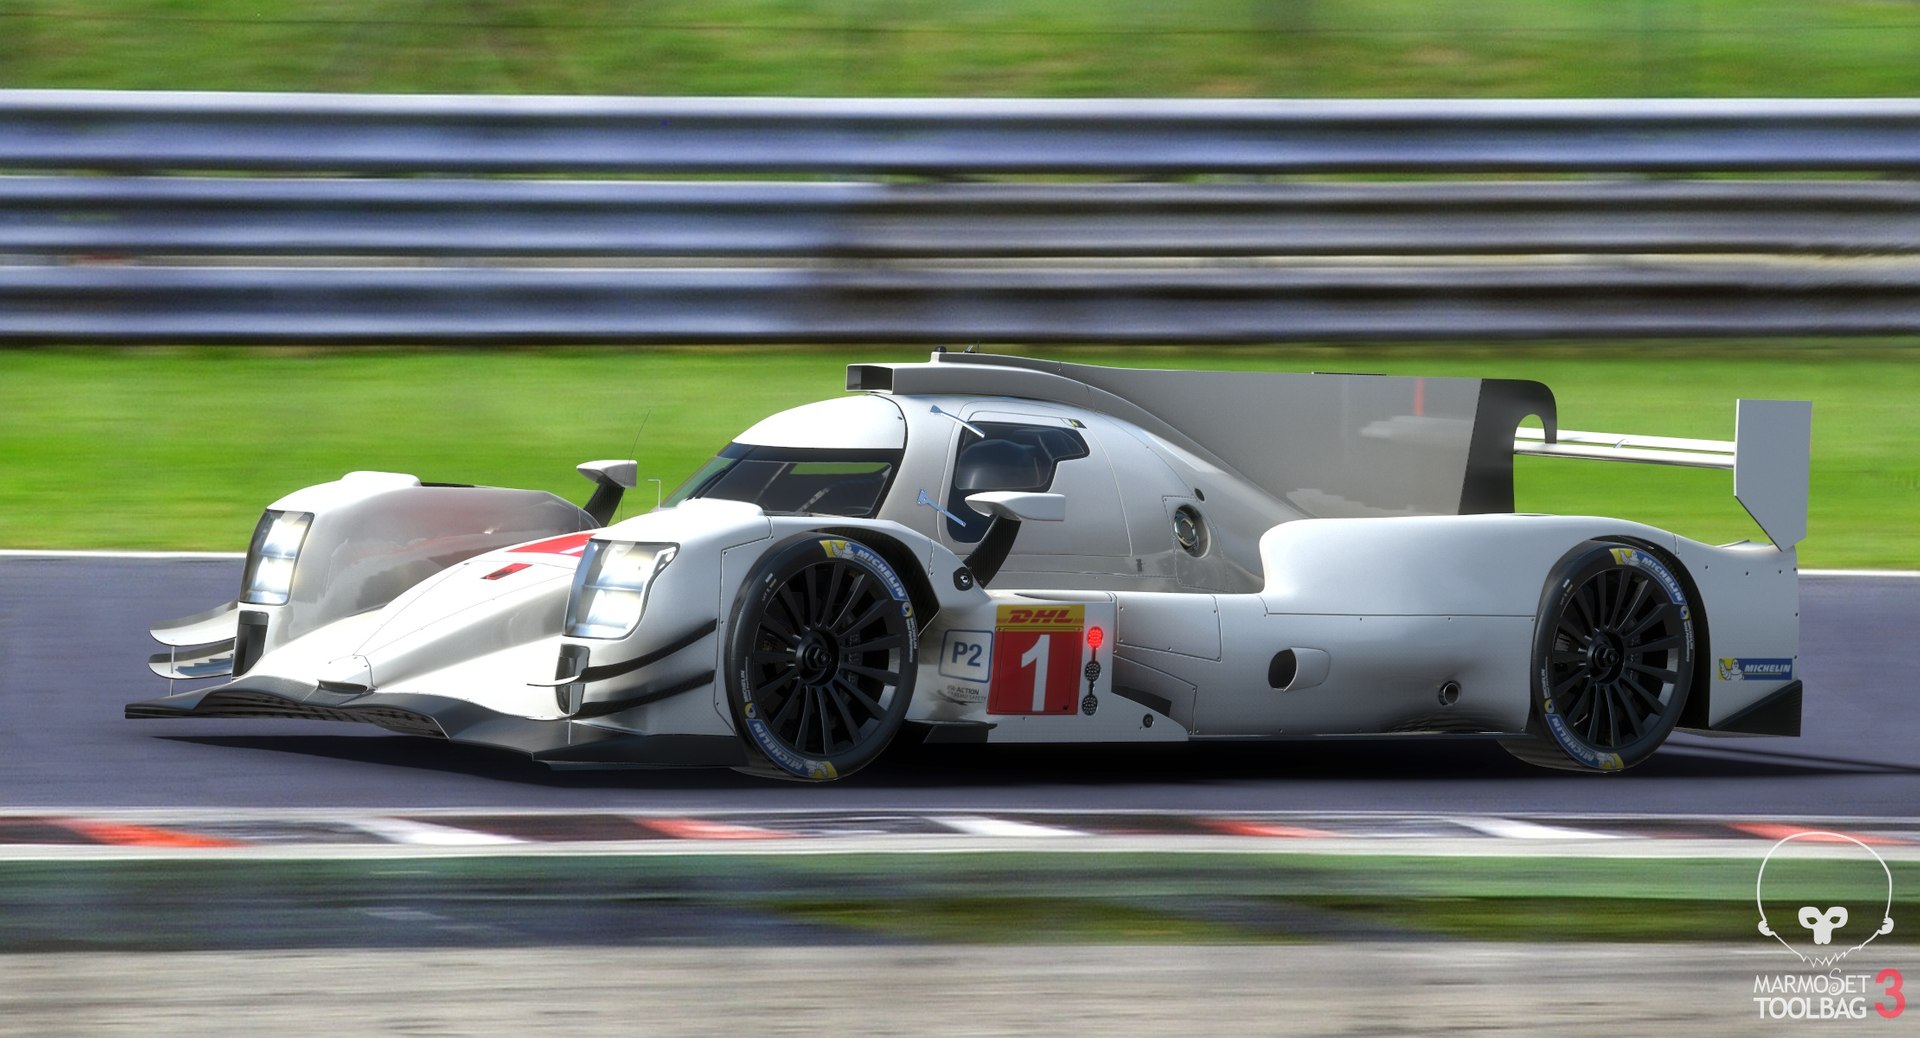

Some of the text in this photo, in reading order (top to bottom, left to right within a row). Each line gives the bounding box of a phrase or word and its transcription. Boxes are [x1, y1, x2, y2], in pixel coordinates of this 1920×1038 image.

[856, 549, 905, 599] MICHELIN
[1641, 556, 1684, 602] MICHELIN
[1008, 609, 1073, 624] DHL
[951, 641, 982, 667] P2
[1021, 634, 1050, 712] 1
[1743, 663, 1792, 673] MICHELIN
[956, 686, 979, 695] ACTION
[754, 722, 802, 770] MICHELIN
[1552, 715, 1594, 762] MICHELIN
